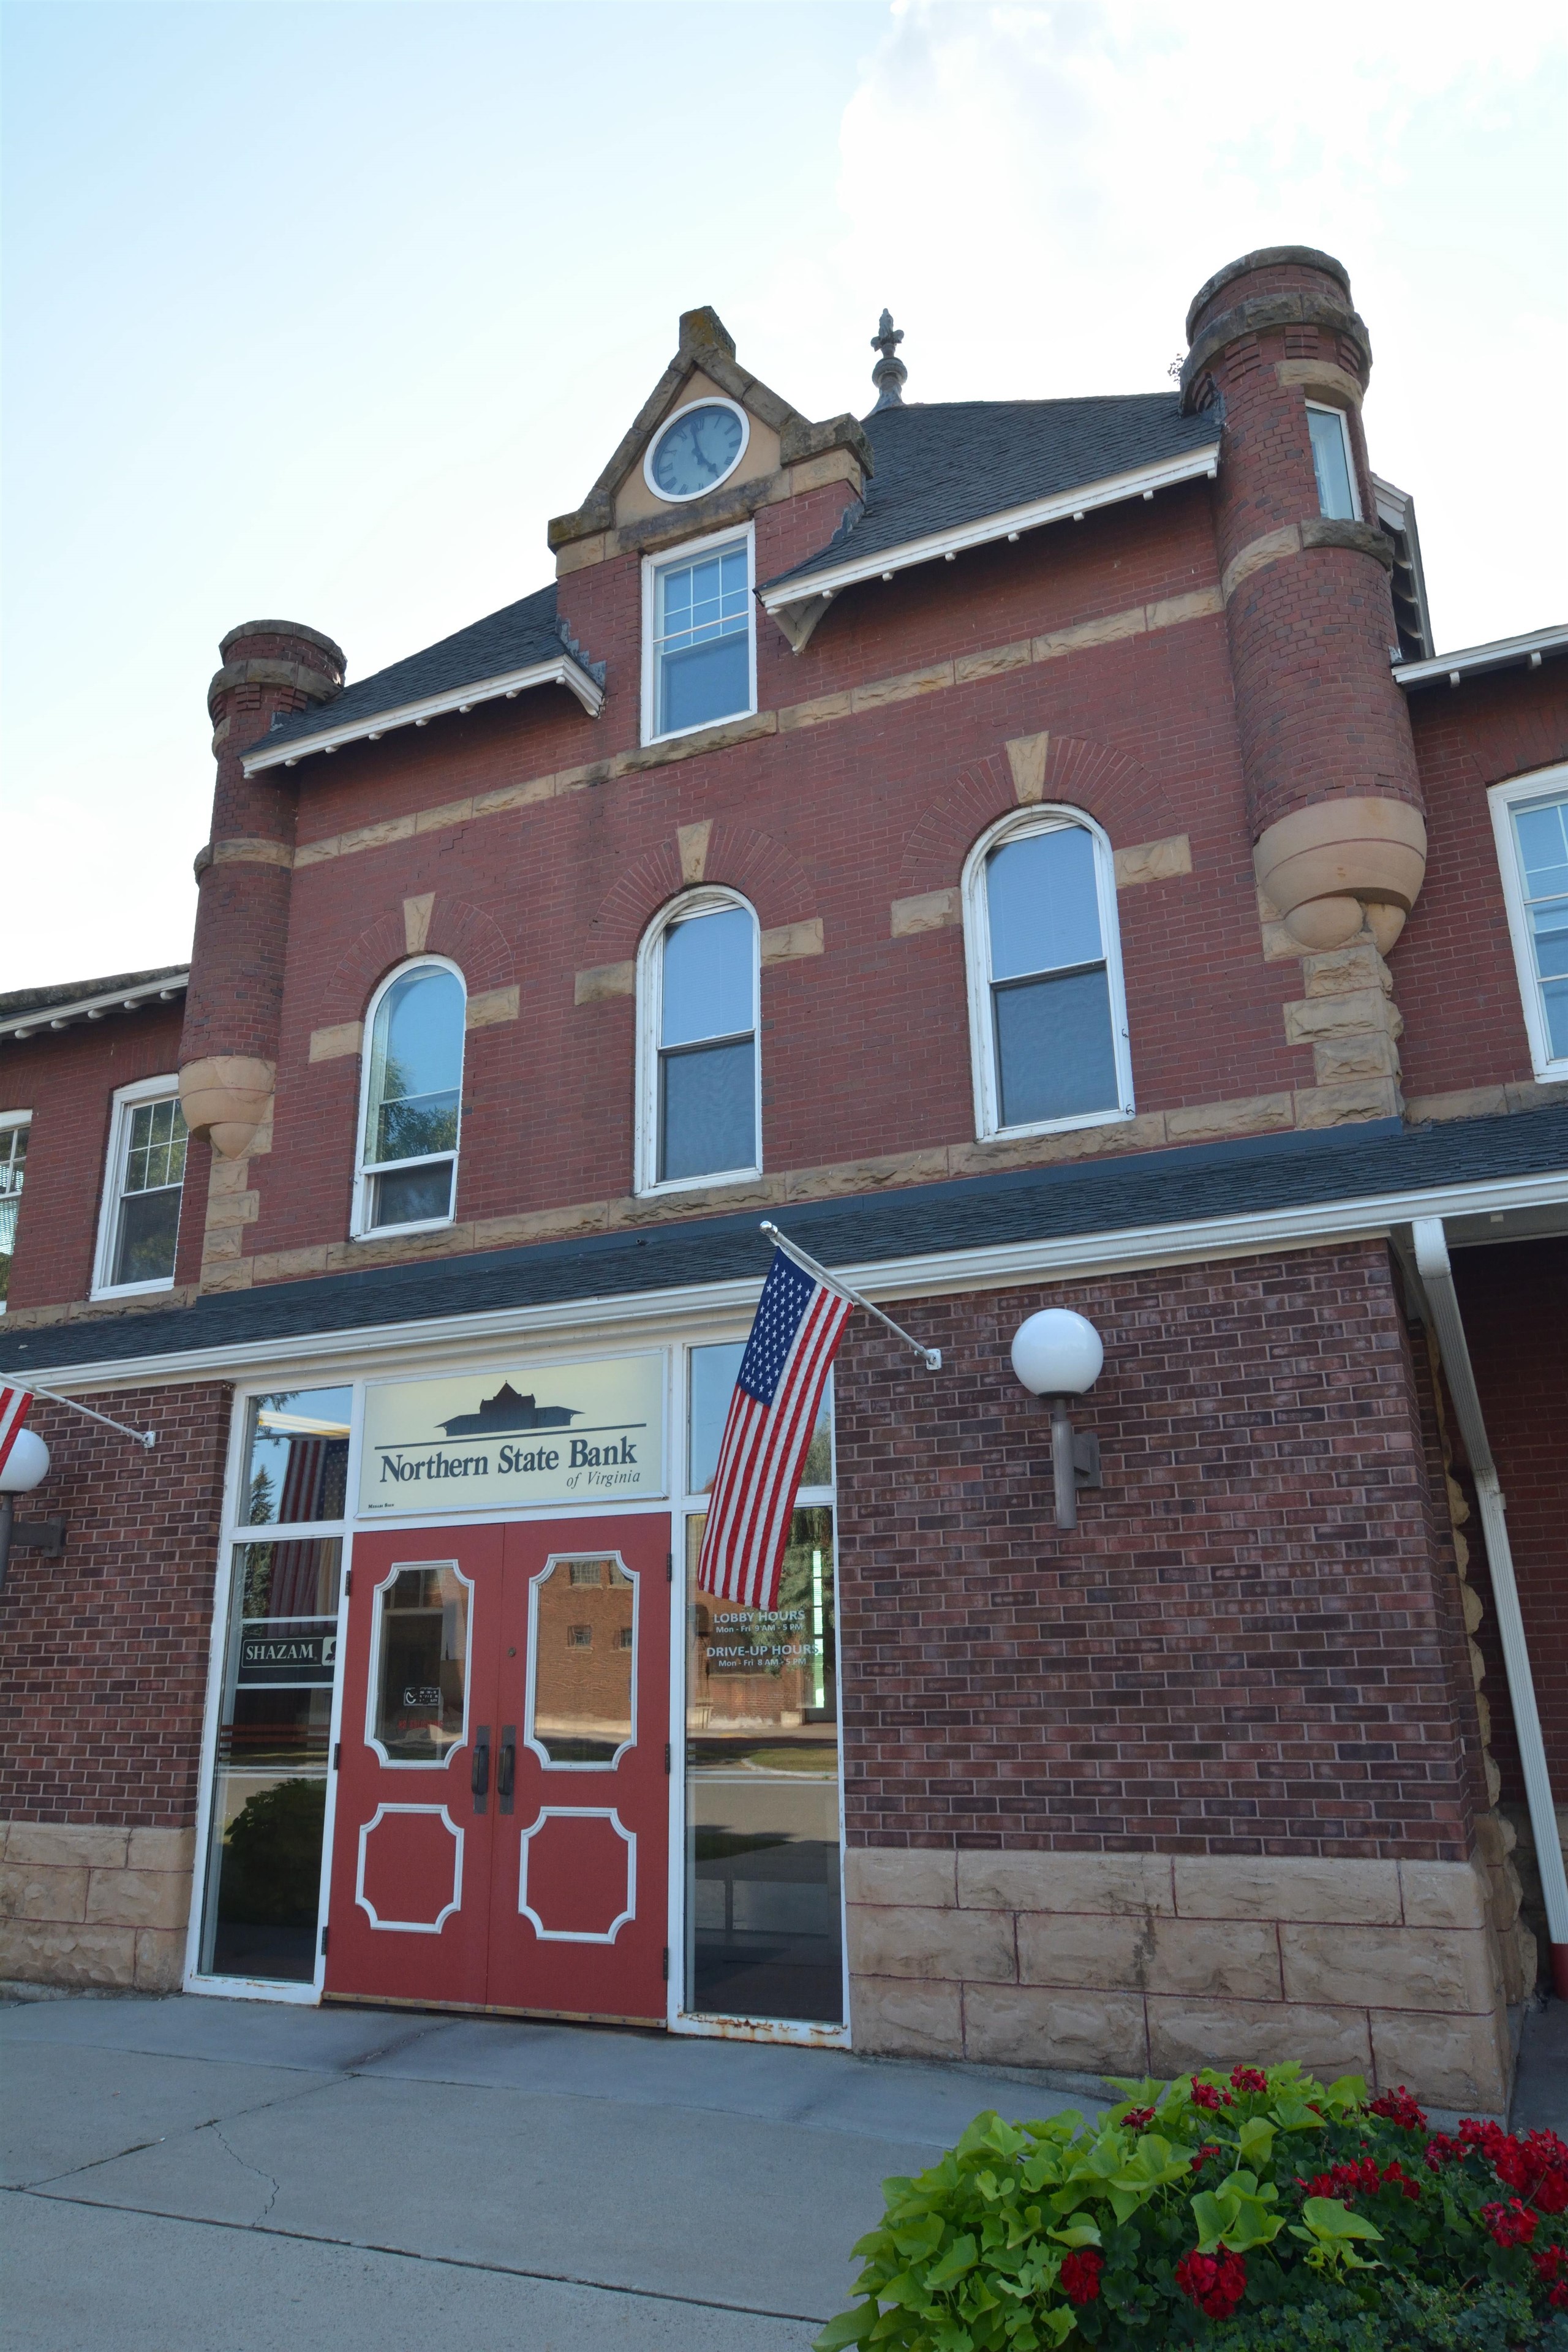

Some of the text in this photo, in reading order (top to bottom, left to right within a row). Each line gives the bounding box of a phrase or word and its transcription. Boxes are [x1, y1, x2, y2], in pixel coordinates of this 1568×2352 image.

[380, 1435, 638, 1483] Northern State Bank
[566, 1470, 641, 1489] of Virginia
[714, 1610, 805, 1623] LOBBY HOURS
[246, 1643, 314, 1660] SHAZAM
[706, 1644, 819, 1657] DRIVE-UP HOURS
